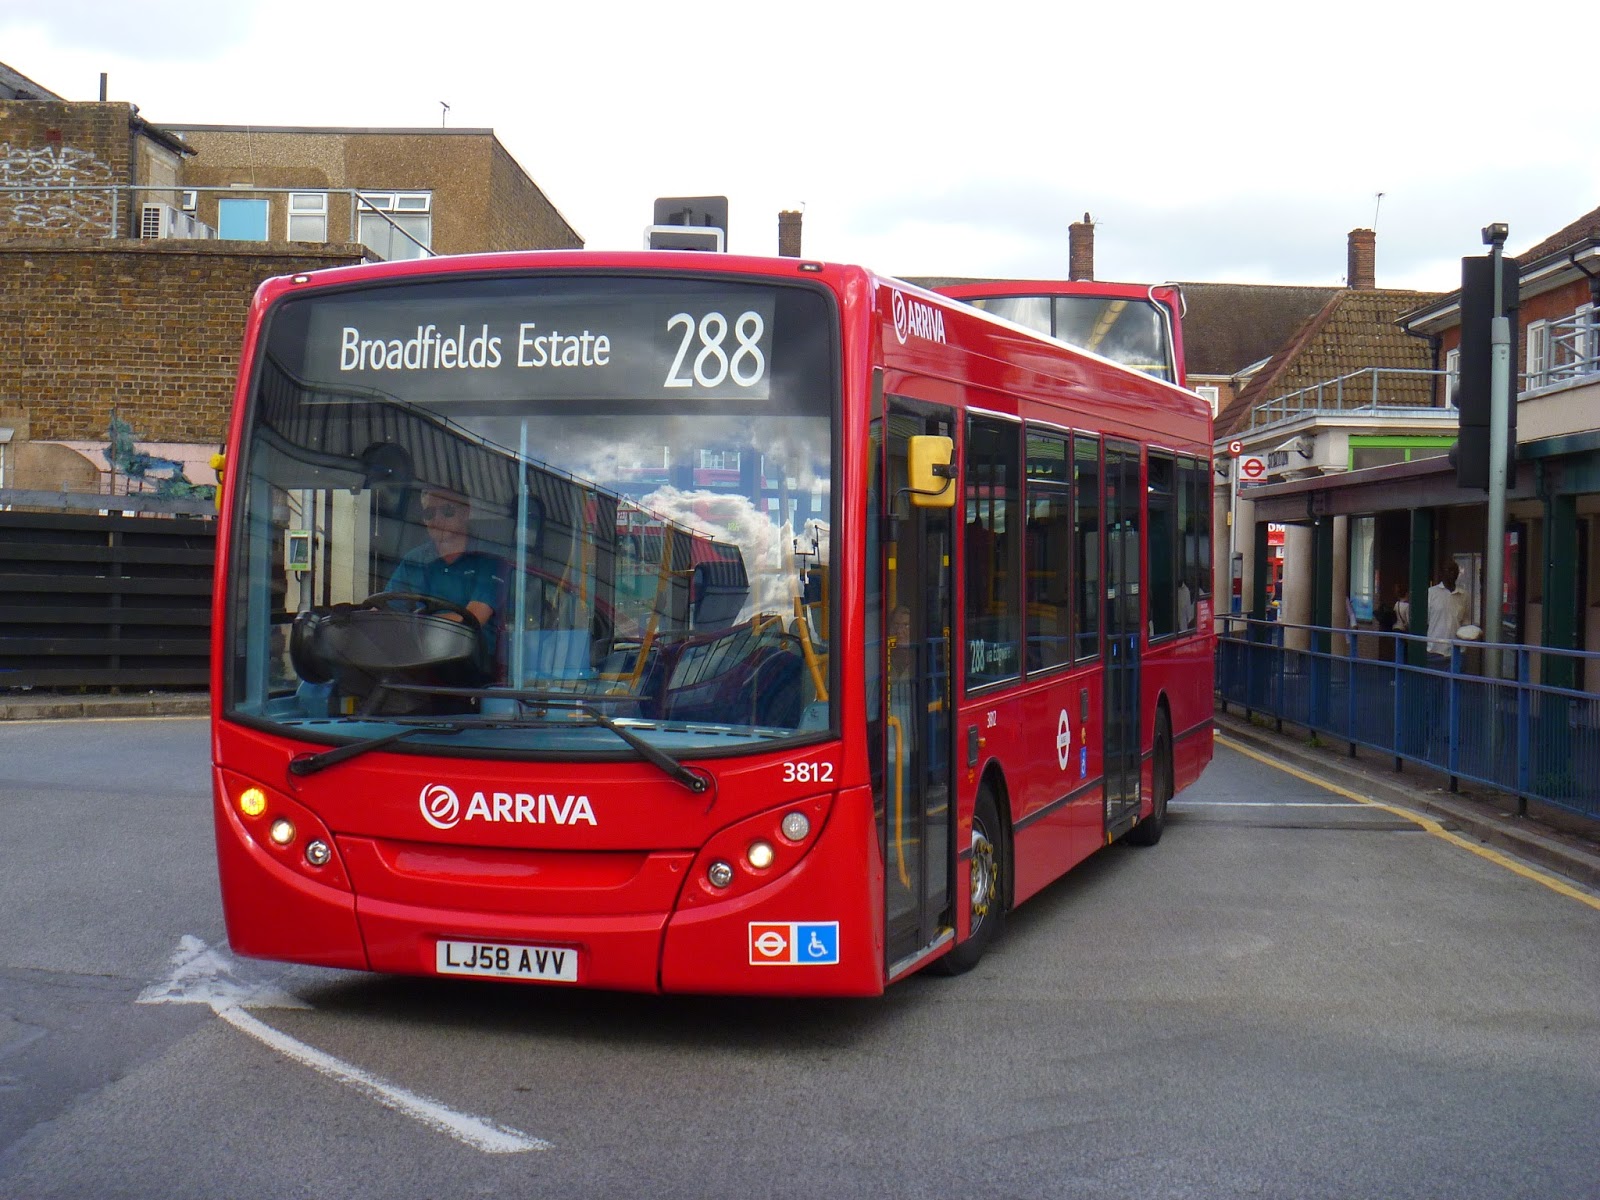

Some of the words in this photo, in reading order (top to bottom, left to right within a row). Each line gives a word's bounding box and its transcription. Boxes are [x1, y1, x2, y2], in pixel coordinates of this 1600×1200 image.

[908, 300, 946, 345] ARRIVA
[340, 325, 502, 371] Broadfields
[517, 322, 610, 367] Estate
[663, 311, 765, 388] 288
[1230, 441, 1241, 453] G
[970, 638, 985, 673] 288
[987, 710, 997, 728] 3812
[782, 762, 834, 783] 3812
[464, 792, 598, 826] ARRIVA
[446, 944, 510, 971] LJ58
[518, 949, 566, 975] AVV
